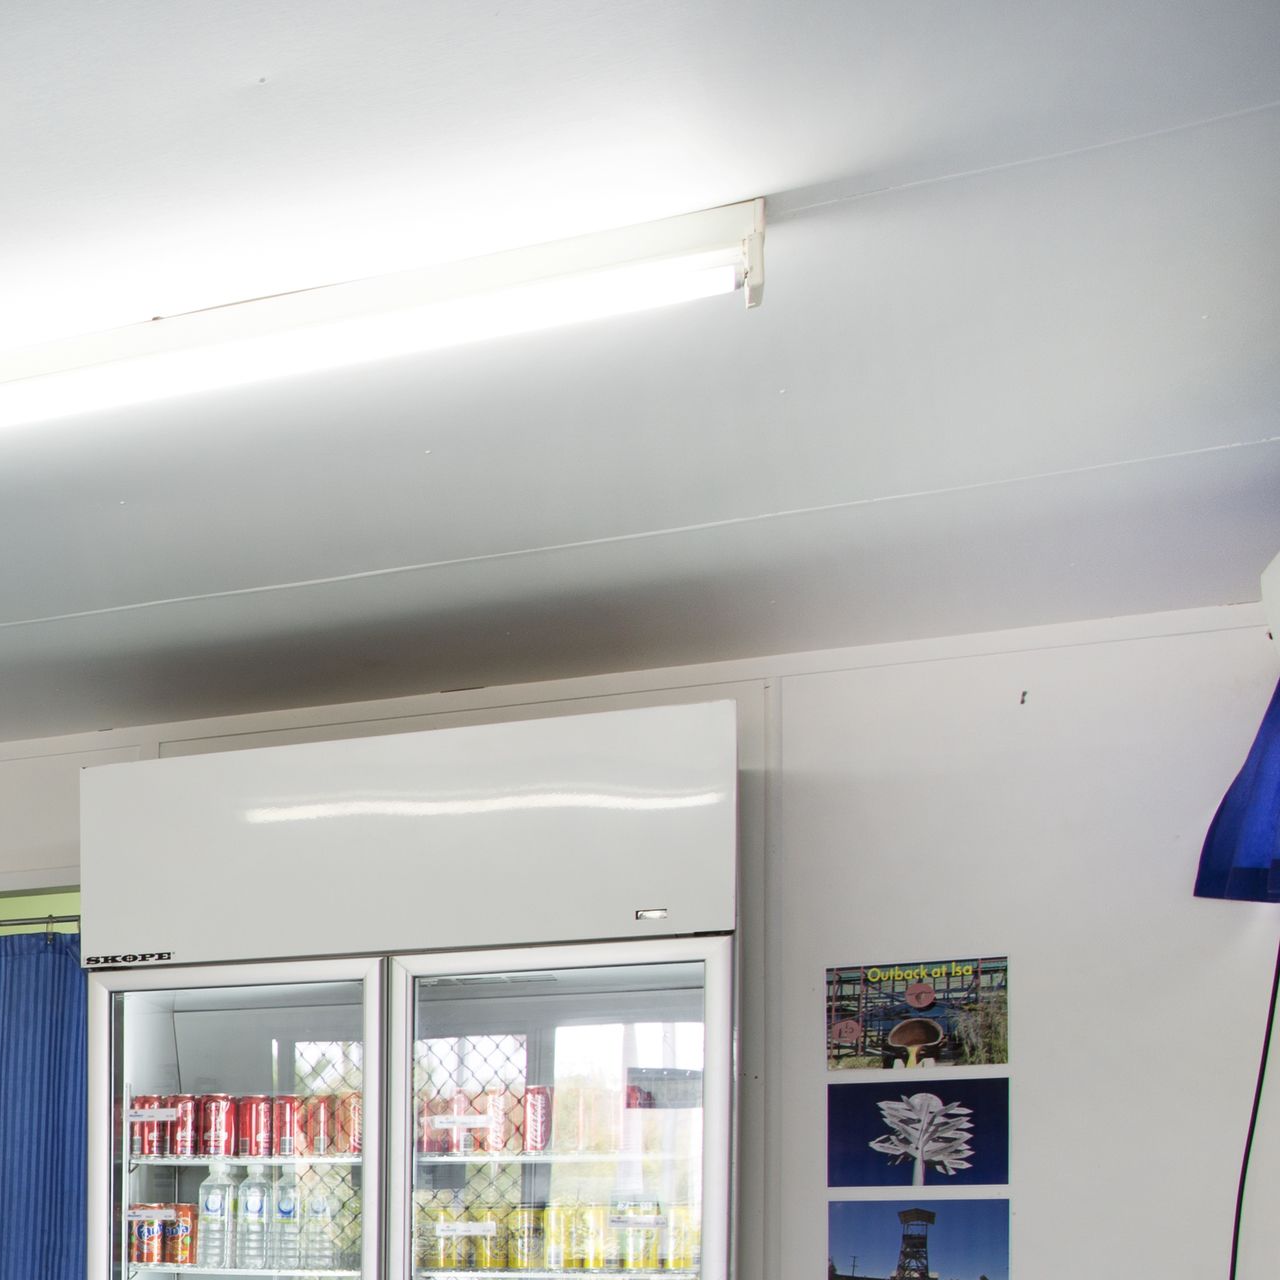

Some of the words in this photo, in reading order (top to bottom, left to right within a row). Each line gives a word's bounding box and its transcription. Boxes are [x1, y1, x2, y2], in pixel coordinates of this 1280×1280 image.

[86, 952, 172, 965] SKOPE
[867, 964, 928, 982] Outback
[931, 964, 948, 978] at
[951, 961, 973, 977] Isa
